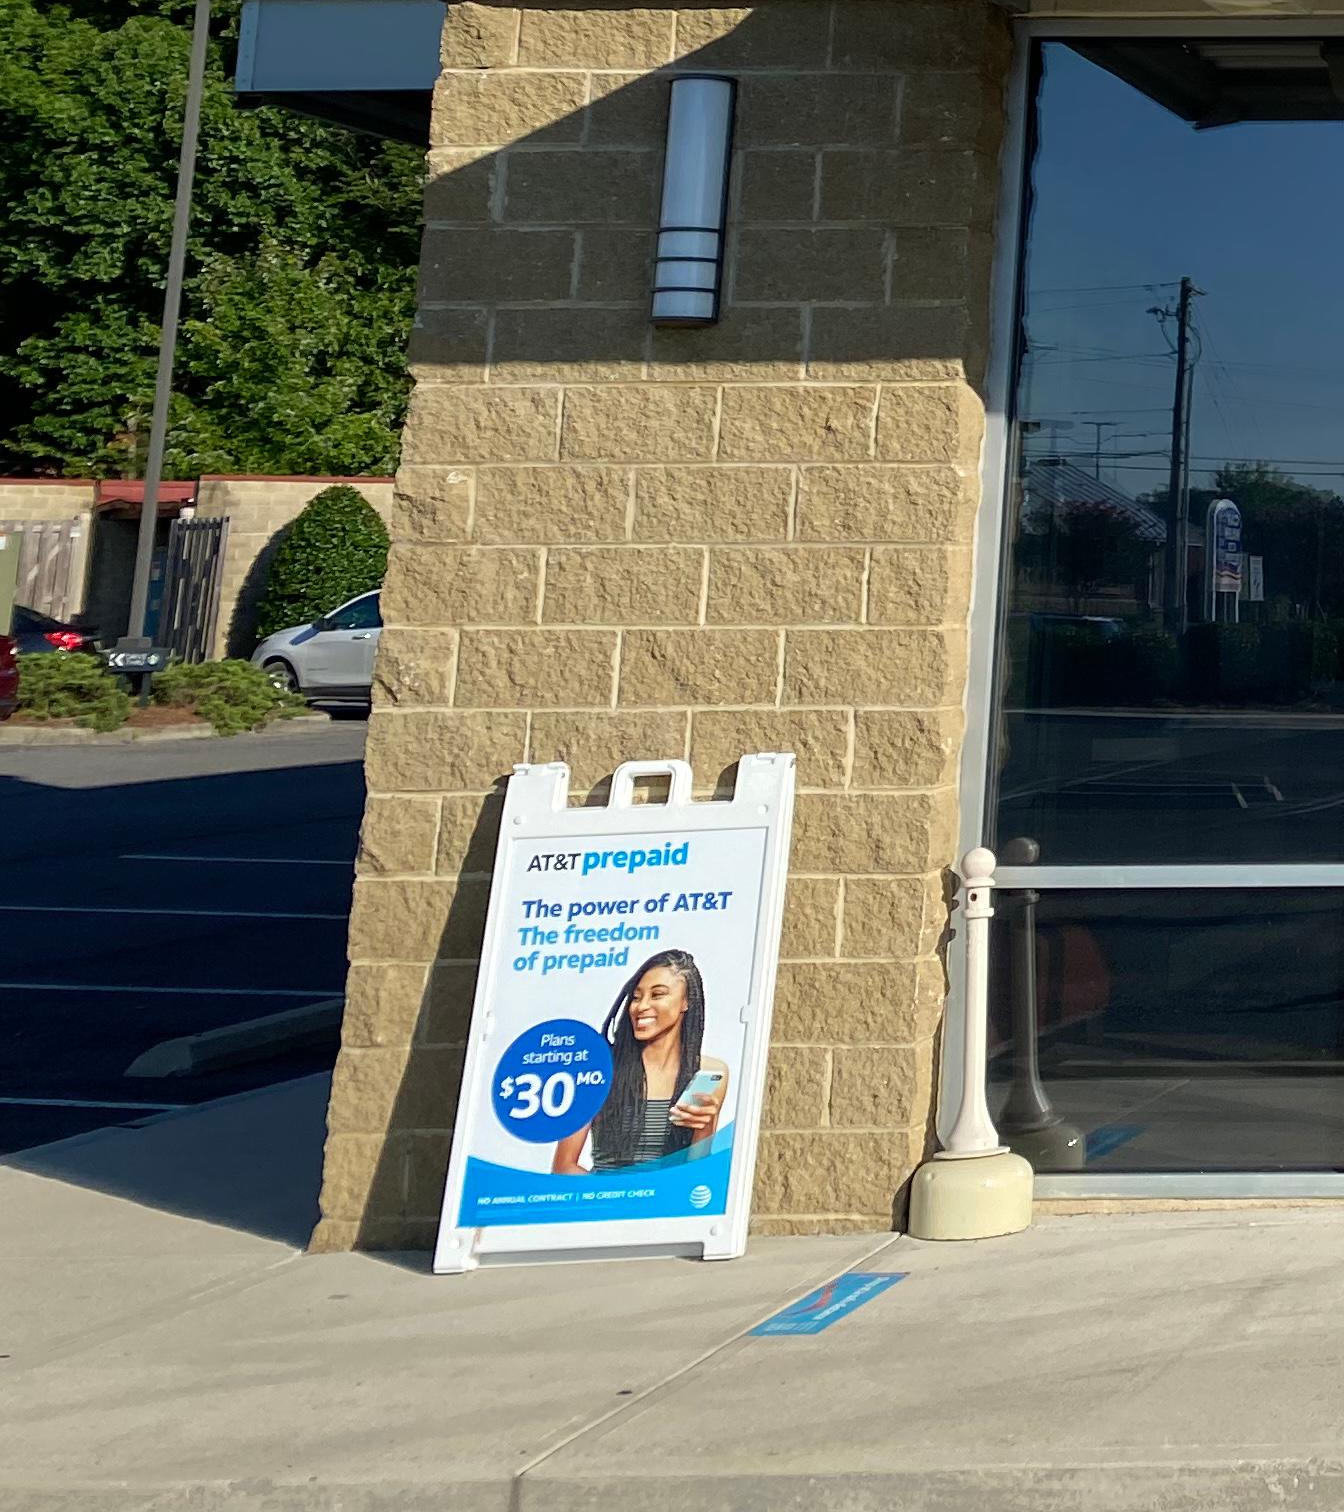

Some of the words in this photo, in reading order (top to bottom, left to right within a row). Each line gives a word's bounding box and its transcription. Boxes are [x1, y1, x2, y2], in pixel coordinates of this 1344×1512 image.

[527, 852, 581, 872] AT&T
[582, 841, 690, 876] prepaid
[521, 898, 562, 919] The
[567, 897, 640, 922] power
[644, 893, 670, 913] of
[672, 891, 732, 912] AT&T
[517, 925, 558, 946] The
[563, 922, 659, 944] freedom
[513, 951, 540, 972] of
[541, 947, 630, 975] prepaid
[540, 1033, 576, 1047] Plans
[522, 1050, 572, 1065] starting
[574, 1049, 589, 1062] at
[499, 1071, 575, 1119] $30
[576, 1070, 606, 1085] MO.
[477, 1197, 491, 1205] NO
[527, 1192, 573, 1203] CONTRACT
[582, 1191, 594, 1200] NO
[595, 1190, 627, 1199] CREDIT
[627, 1189, 656, 1198] CHECK
